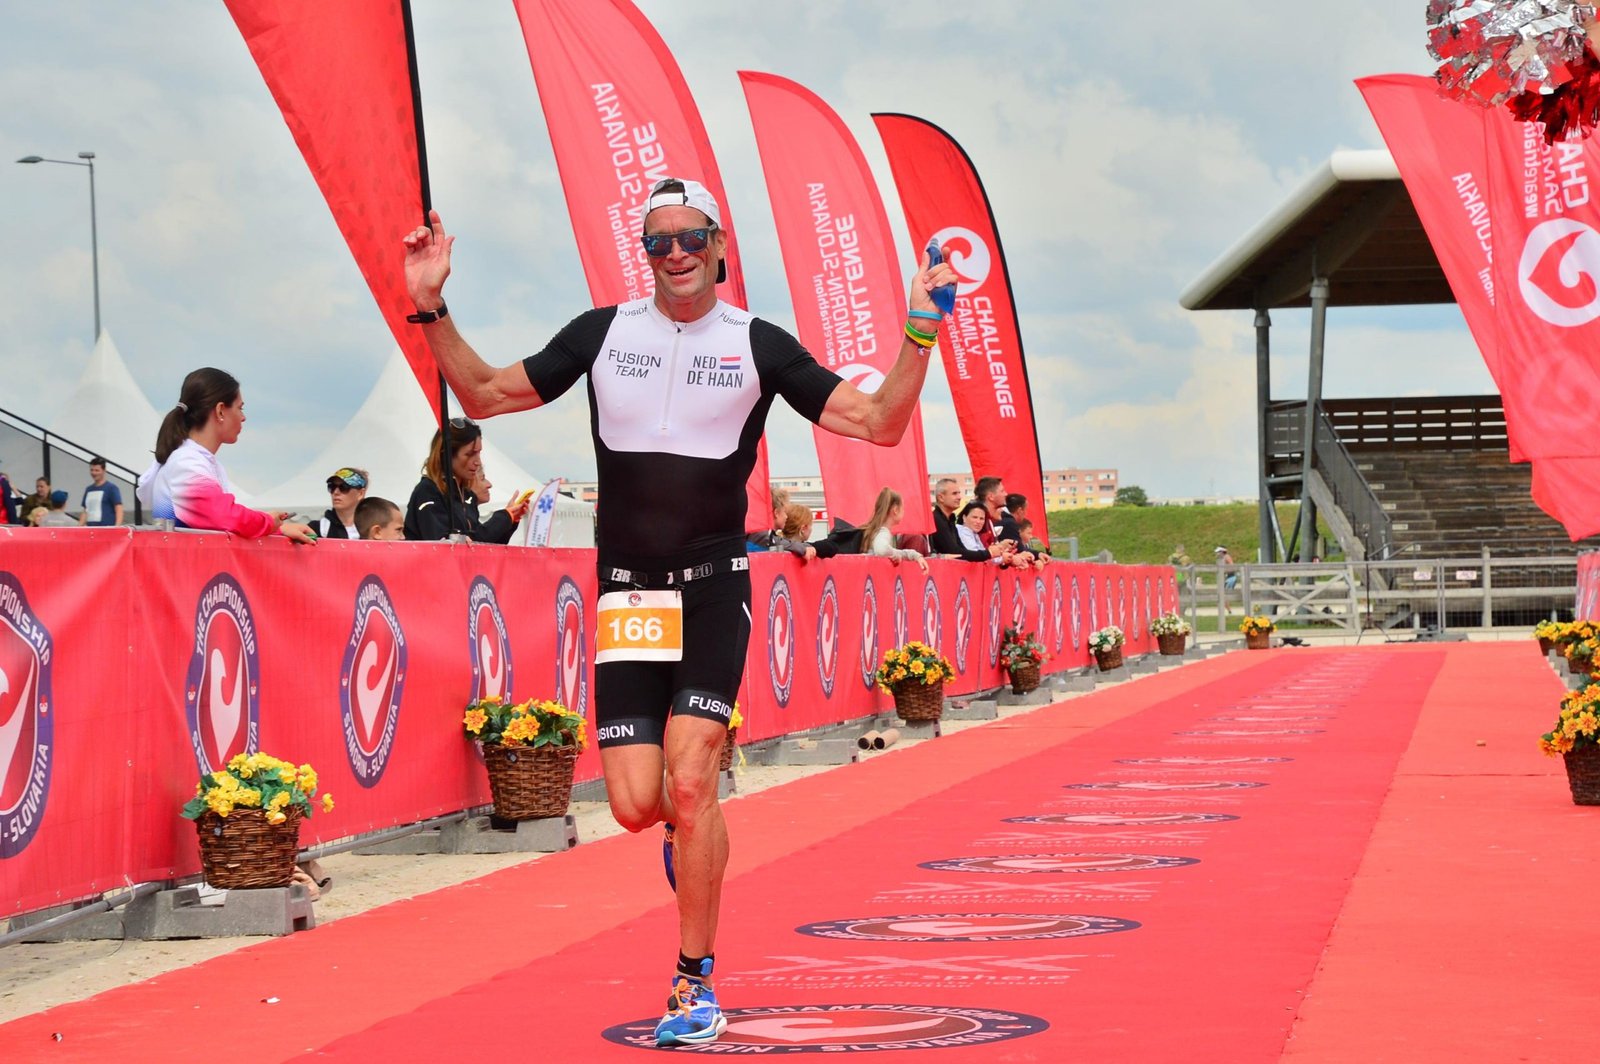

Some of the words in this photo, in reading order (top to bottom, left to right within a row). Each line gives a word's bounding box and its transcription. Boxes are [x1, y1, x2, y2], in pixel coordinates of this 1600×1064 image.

[954, 297, 983, 355] FAMILY
[608, 349, 662, 368] FUSION
[692, 355, 717, 370] NED
[973, 296, 1016, 418] CHALLENGE
[615, 365, 649, 379] TEAM
[686, 370, 704, 386] DE
[707, 371, 744, 389] HAAN
[196, 612, 207, 657] THE
[202, 582, 256, 656] CHAMPIONSHIP
[350, 608, 365, 648] THE
[608, 616, 664, 642] 166
[10, 743, 49, 842] SLOVAKIA
[741, 1004, 1020, 1022] CHAMPIONSHIP
[820, 1031, 1012, 1053] SLOVAKIA
